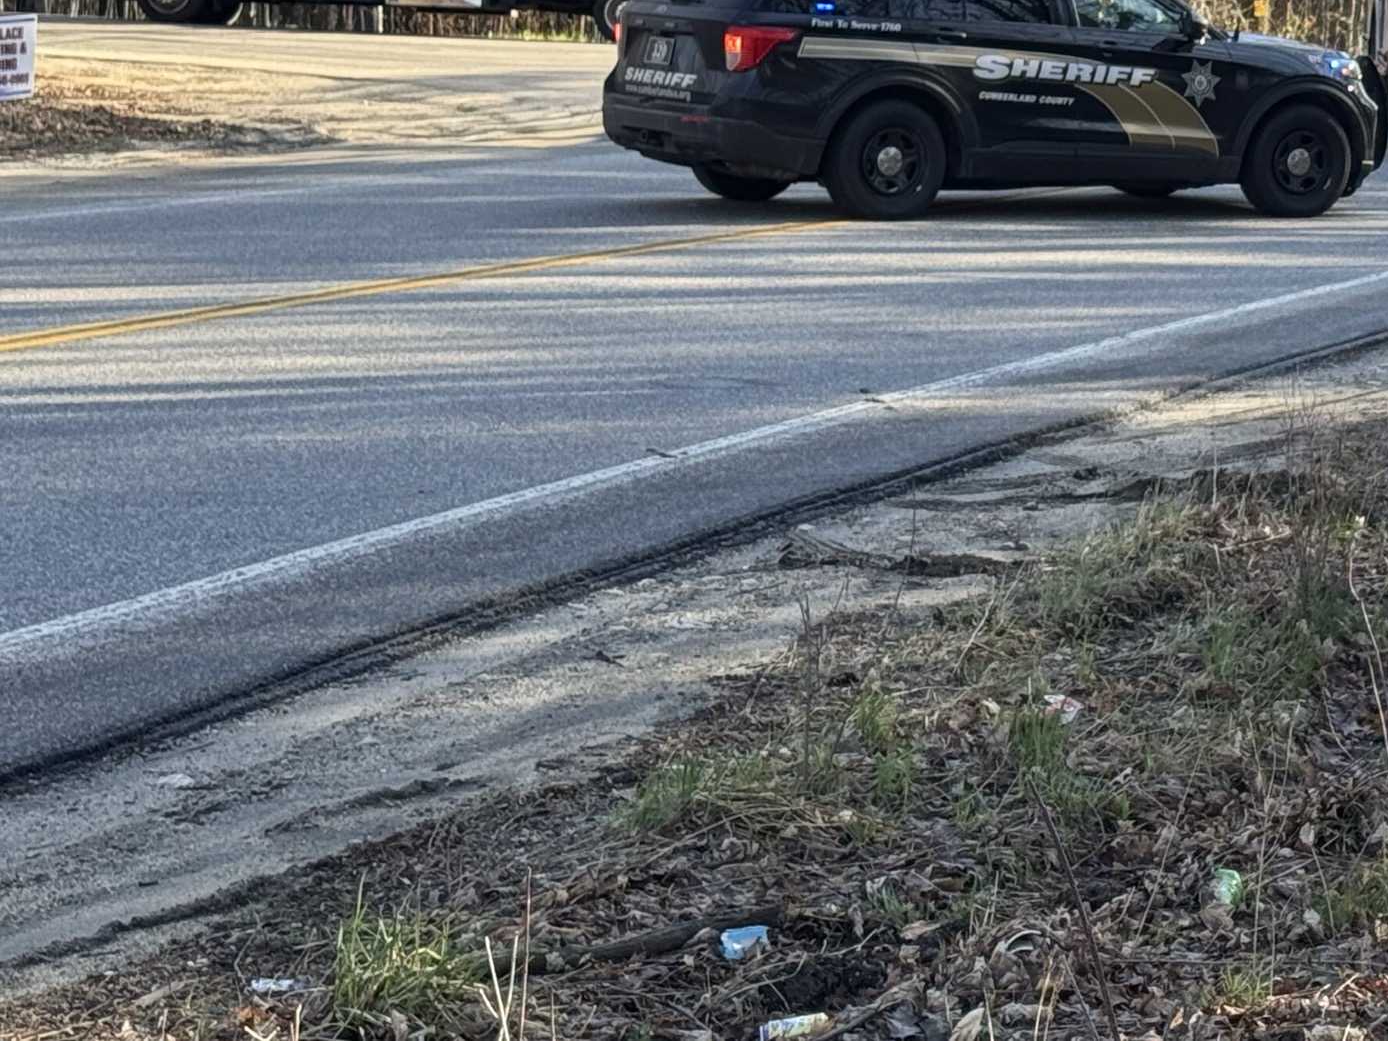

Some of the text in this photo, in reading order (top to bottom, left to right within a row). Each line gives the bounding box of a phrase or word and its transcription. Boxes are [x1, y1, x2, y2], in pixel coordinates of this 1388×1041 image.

[625, 66, 697, 88] SHERIFF
[973, 55, 1158, 87] SHERIFF
[979, 90, 1075, 107] CUMBERLAND COUNTY
